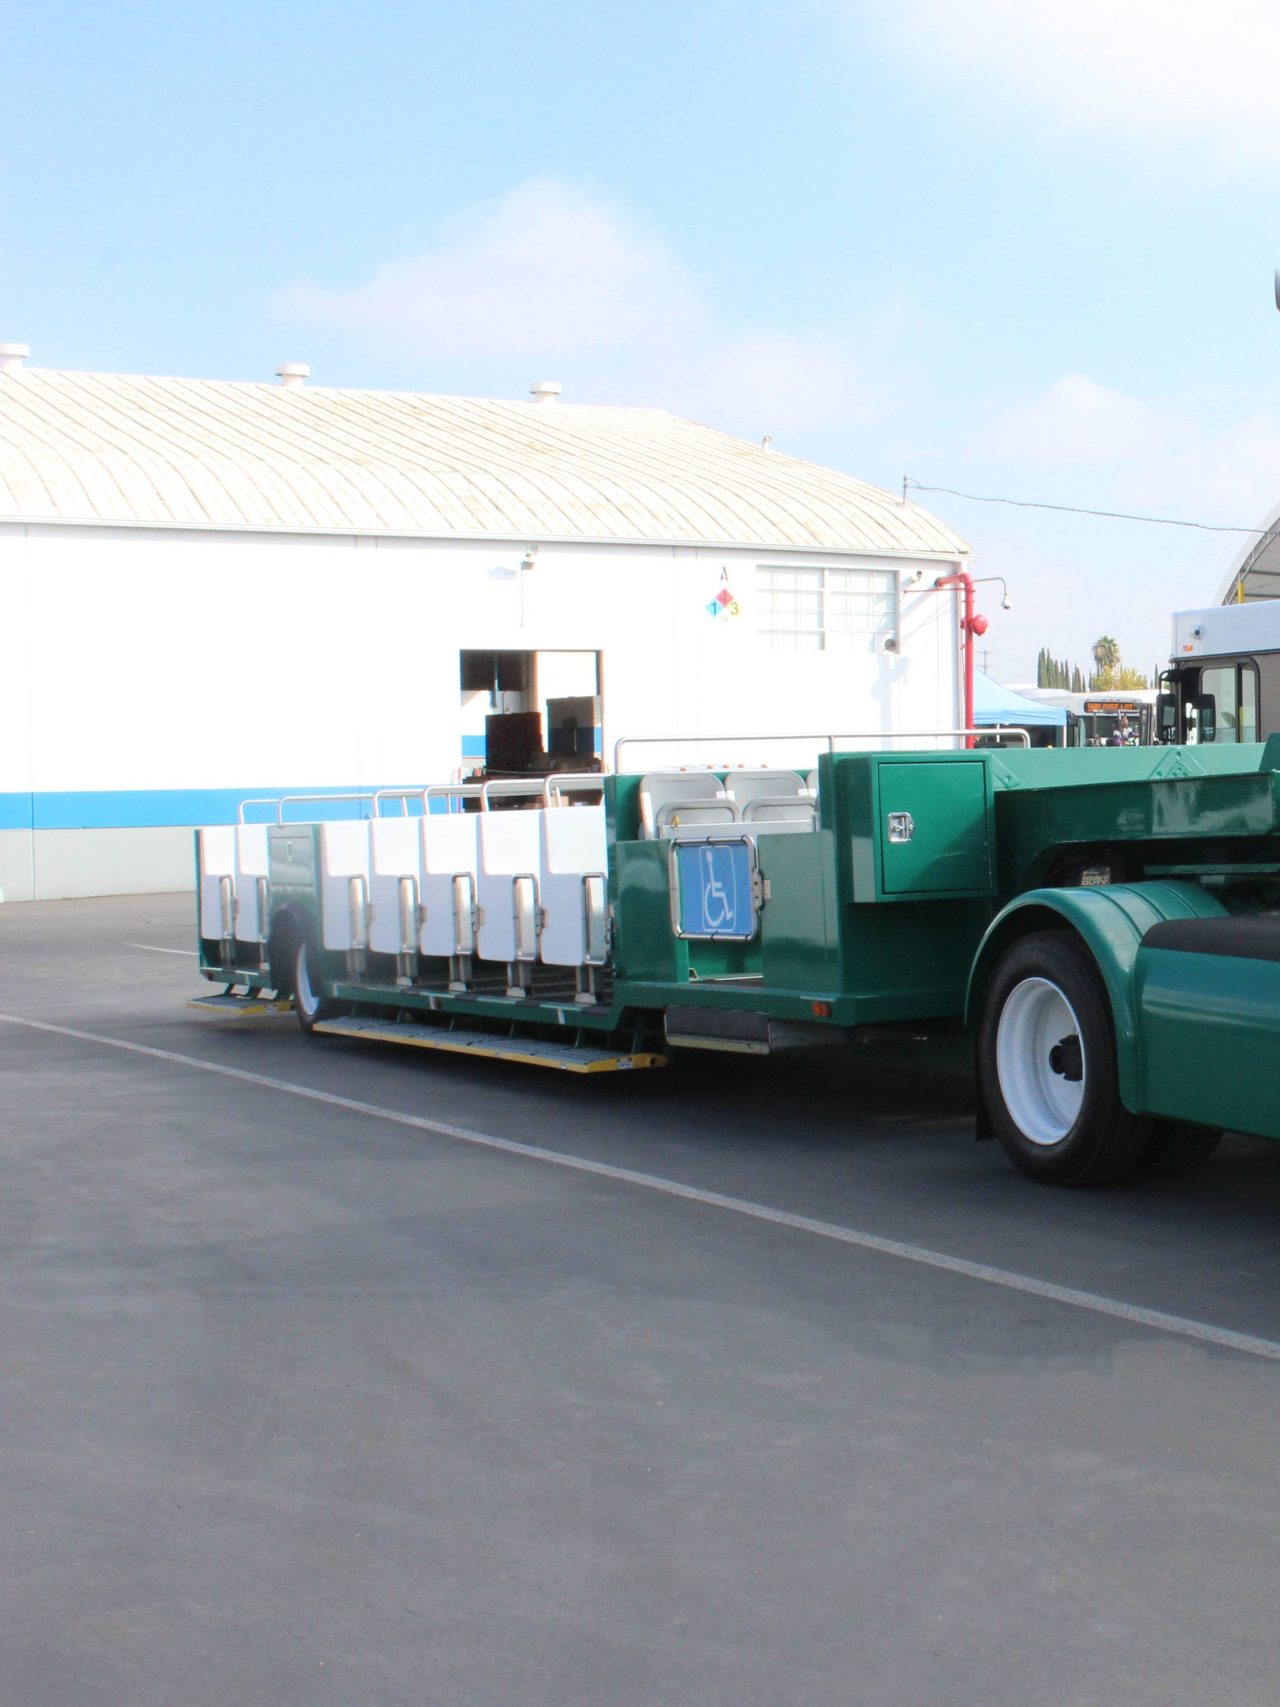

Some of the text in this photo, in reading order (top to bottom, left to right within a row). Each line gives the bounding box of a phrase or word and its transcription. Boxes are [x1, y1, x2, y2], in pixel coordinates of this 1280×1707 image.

[720, 565, 729, 581] A
[711, 601, 717, 615] 1
[730, 601, 739, 615] 3
[1087, 703, 1119, 712] EMPLOYEE
[1082, 874, 1109, 882] HEAVY
